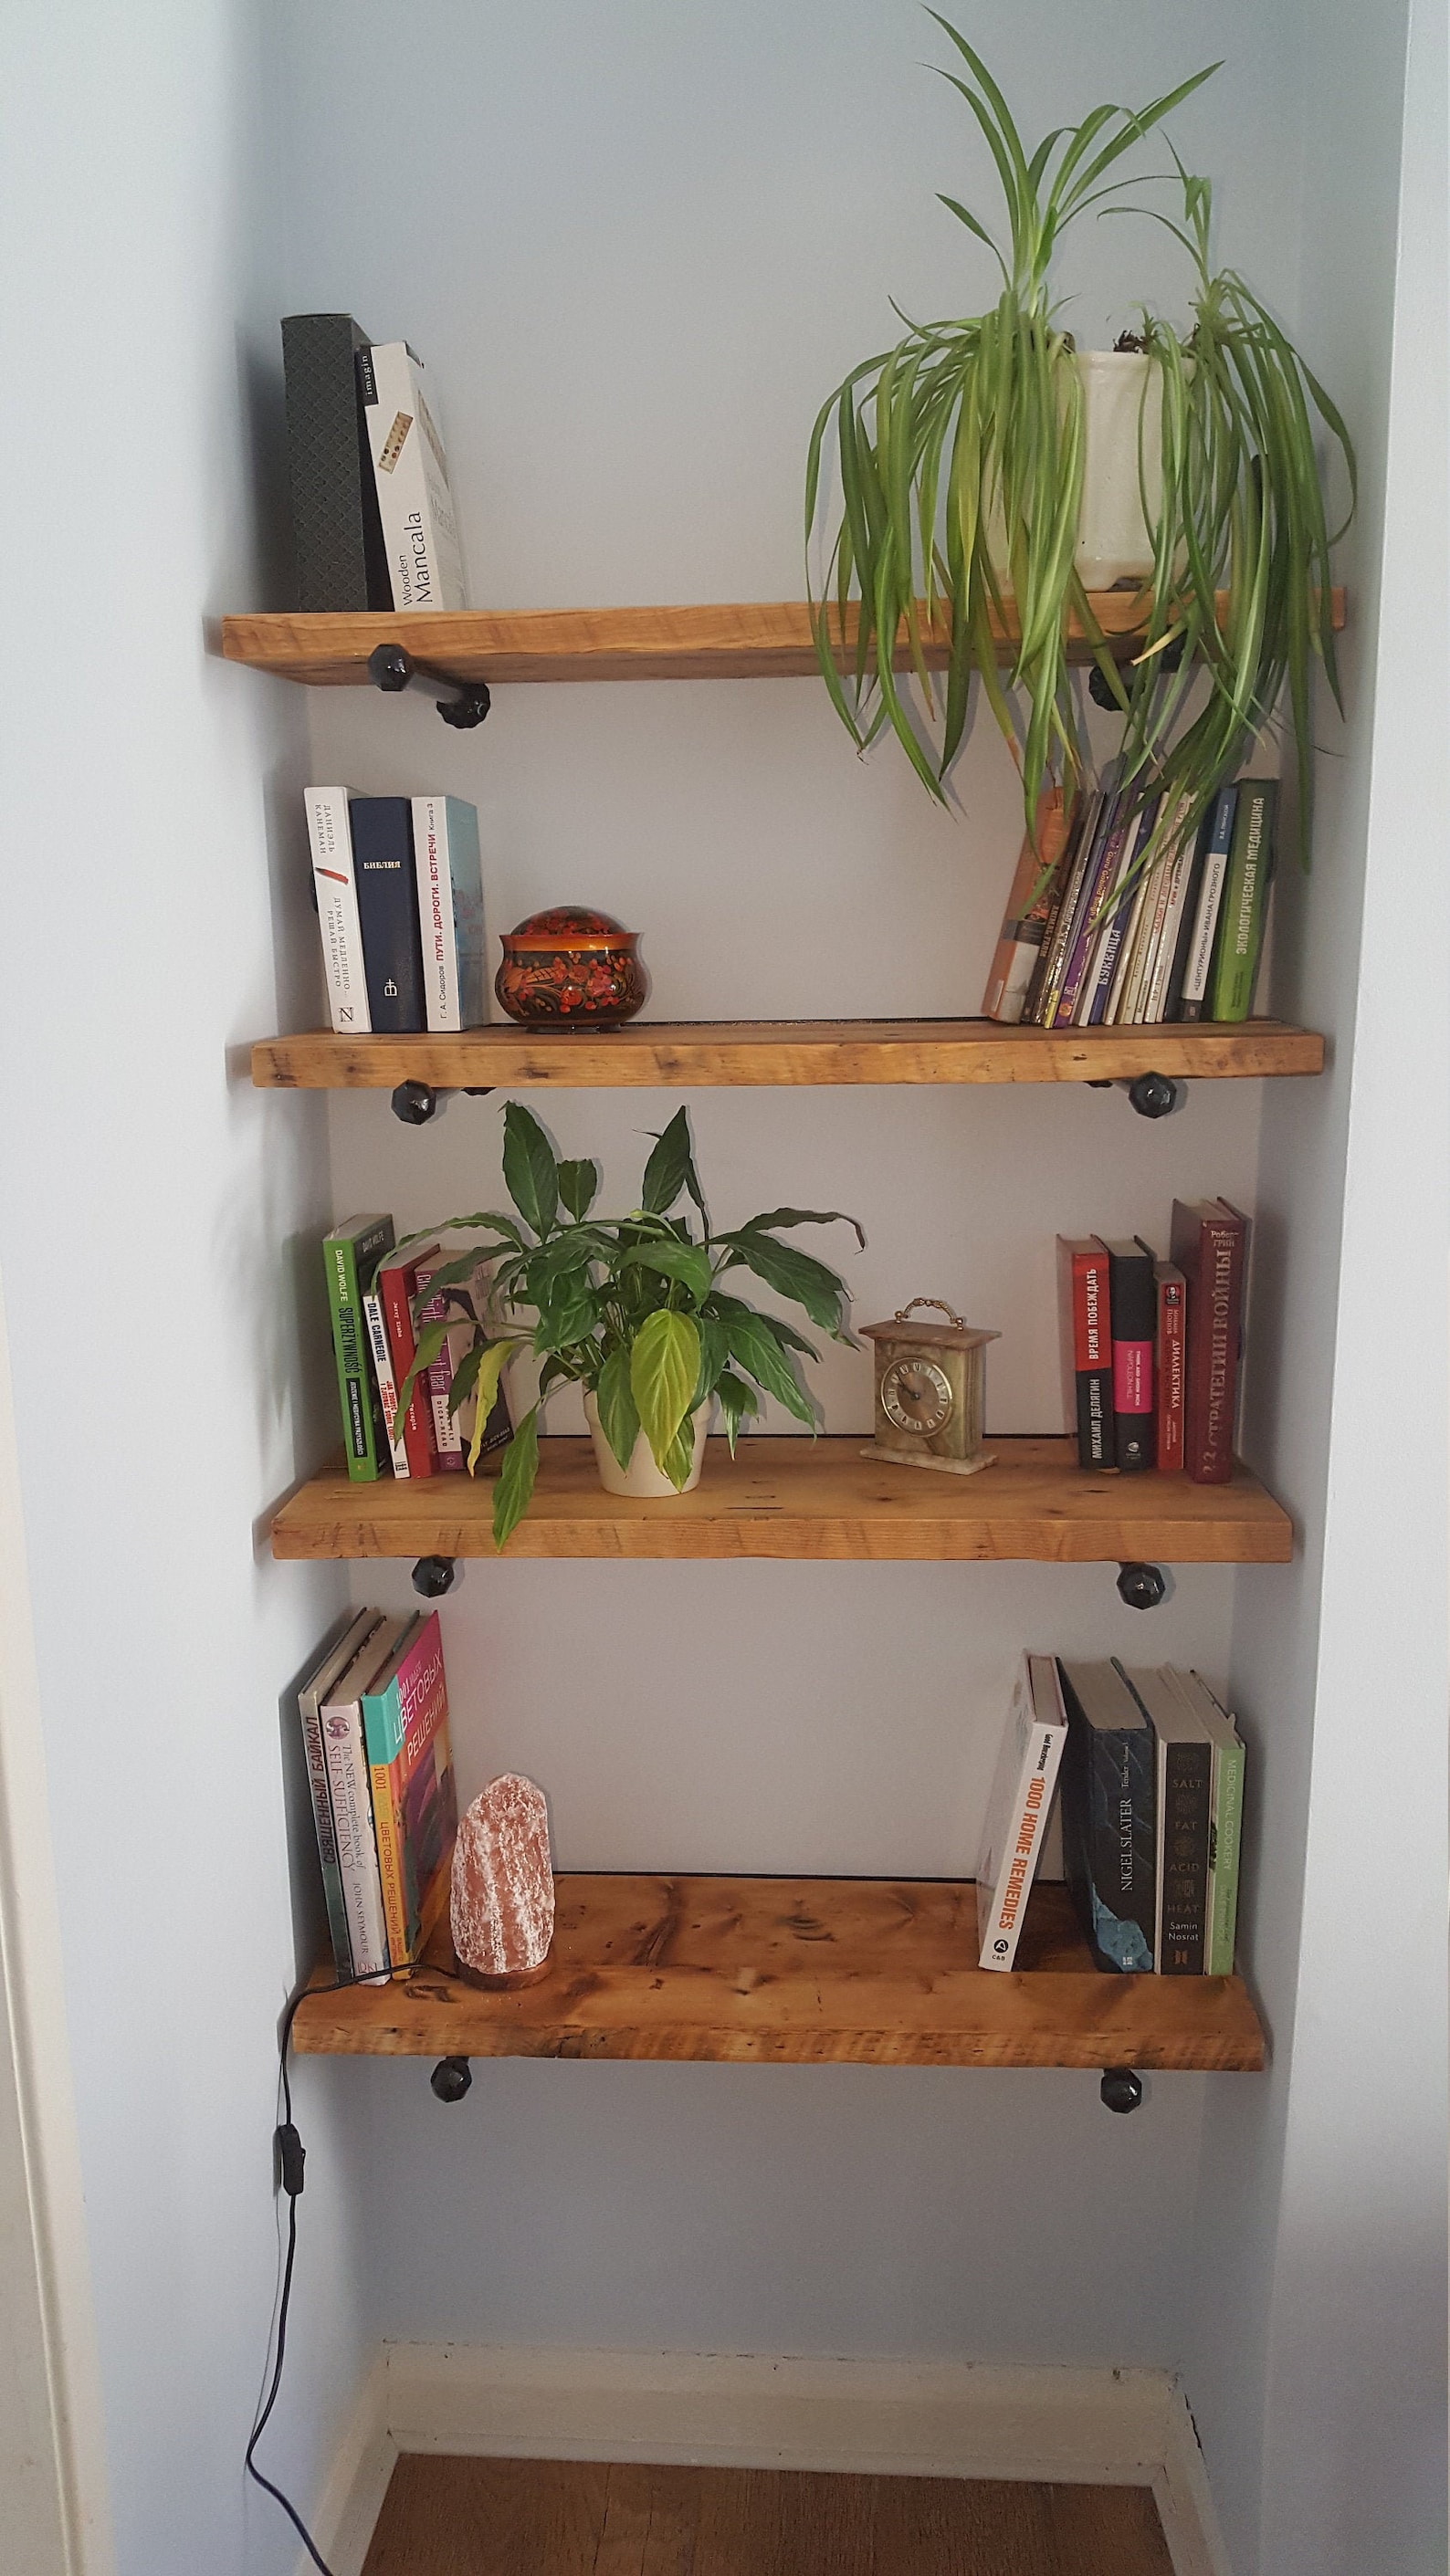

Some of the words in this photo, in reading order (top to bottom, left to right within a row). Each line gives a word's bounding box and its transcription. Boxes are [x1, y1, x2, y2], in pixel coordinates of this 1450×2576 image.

[362, 355, 373, 395] imagin
[404, 511, 433, 602] Mancala
[397, 554, 413, 606] Wooden
[315, 804, 326, 853] КАНЕМАН
[323, 805, 335, 852] ДАНИЭЛЬ
[363, 861, 401, 869] БИБЛИЯ
[427, 834, 438, 881] ВСТРЕЧИ
[1235, 864, 1257, 955] ЭКОЛОГИЧЕСКАЯ
[1246, 797, 1265, 860] МЕДИЦИНА
[1207, 864, 1221, 905] ГРОЗНОГО
[333, 897, 345, 931] ДУМАЙ
[432, 884, 443, 929] ДОРОГИ.
[1203, 905, 1214, 930] ИВАНА
[327, 910, 337, 944] РЕШАЙ
[435, 932, 444, 960] ПУТИ.
[331, 948, 341, 987] БЫСТРО
[438, 966, 447, 1000] Сидоров
[335, 1250, 345, 1276] DAVID
[337, 1276, 349, 1302] WOLFE
[1087, 1269, 1099, 1325] ПОБЕЖДАТЬ
[368, 1303, 379, 1323] DALE
[372, 1325, 387, 1362] CARNEGIE
[1088, 1329, 1099, 1359] ВРЕМЯ
[1089, 1378, 1103, 1418] ДЕЛЯГИН
[436, 1400, 447, 1447] DICK-READ
[1090, 1419, 1102, 1460] МИХАИЛ
[394, 1648, 442, 1744] ЦВЕТОВЫХ
[396, 1678, 409, 1709] 1001
[306, 1716, 324, 1772] БАЙКАЛ
[407, 1683, 446, 1765] РЕШЕНИЙ
[329, 1745, 343, 1775] SELF
[345, 1763, 357, 1790] NEW
[1025, 1777, 1045, 1809] 1000
[1172, 1779, 1203, 1788] SALT
[1225, 1760, 1236, 1817] MEDICINAL
[312, 1779, 336, 1864] СВЯЩЕННЫЙ
[332, 1780, 355, 1871] SUFFICIENCY
[348, 1791, 360, 1833] complete
[1119, 1798, 1132, 1848] SLATER
[1175, 1821, 1198, 1830] FAT
[352, 1834, 364, 1859] book
[373, 1767, 386, 1790] 1001
[380, 1822, 394, 1879] ЦВЕТОВЫХ
[388, 1883, 401, 1933] РЕШЕНИЙ
[1015, 1813, 1038, 1855] HOME
[1224, 1820, 1234, 1869] COOKERY
[1120, 1849, 1132, 1891] NIGEL
[1170, 1863, 1200, 1871] ACID
[999, 1858, 1028, 1930] REMEDIES
[1167, 1904, 1201, 1913] HEAT
[352, 1883, 362, 1908] JOHN
[357, 1911, 368, 1953] SEYMOUR
[1168, 1932, 1199, 1941] Nosrat
[1170, 1922, 1198, 1930] Samin
